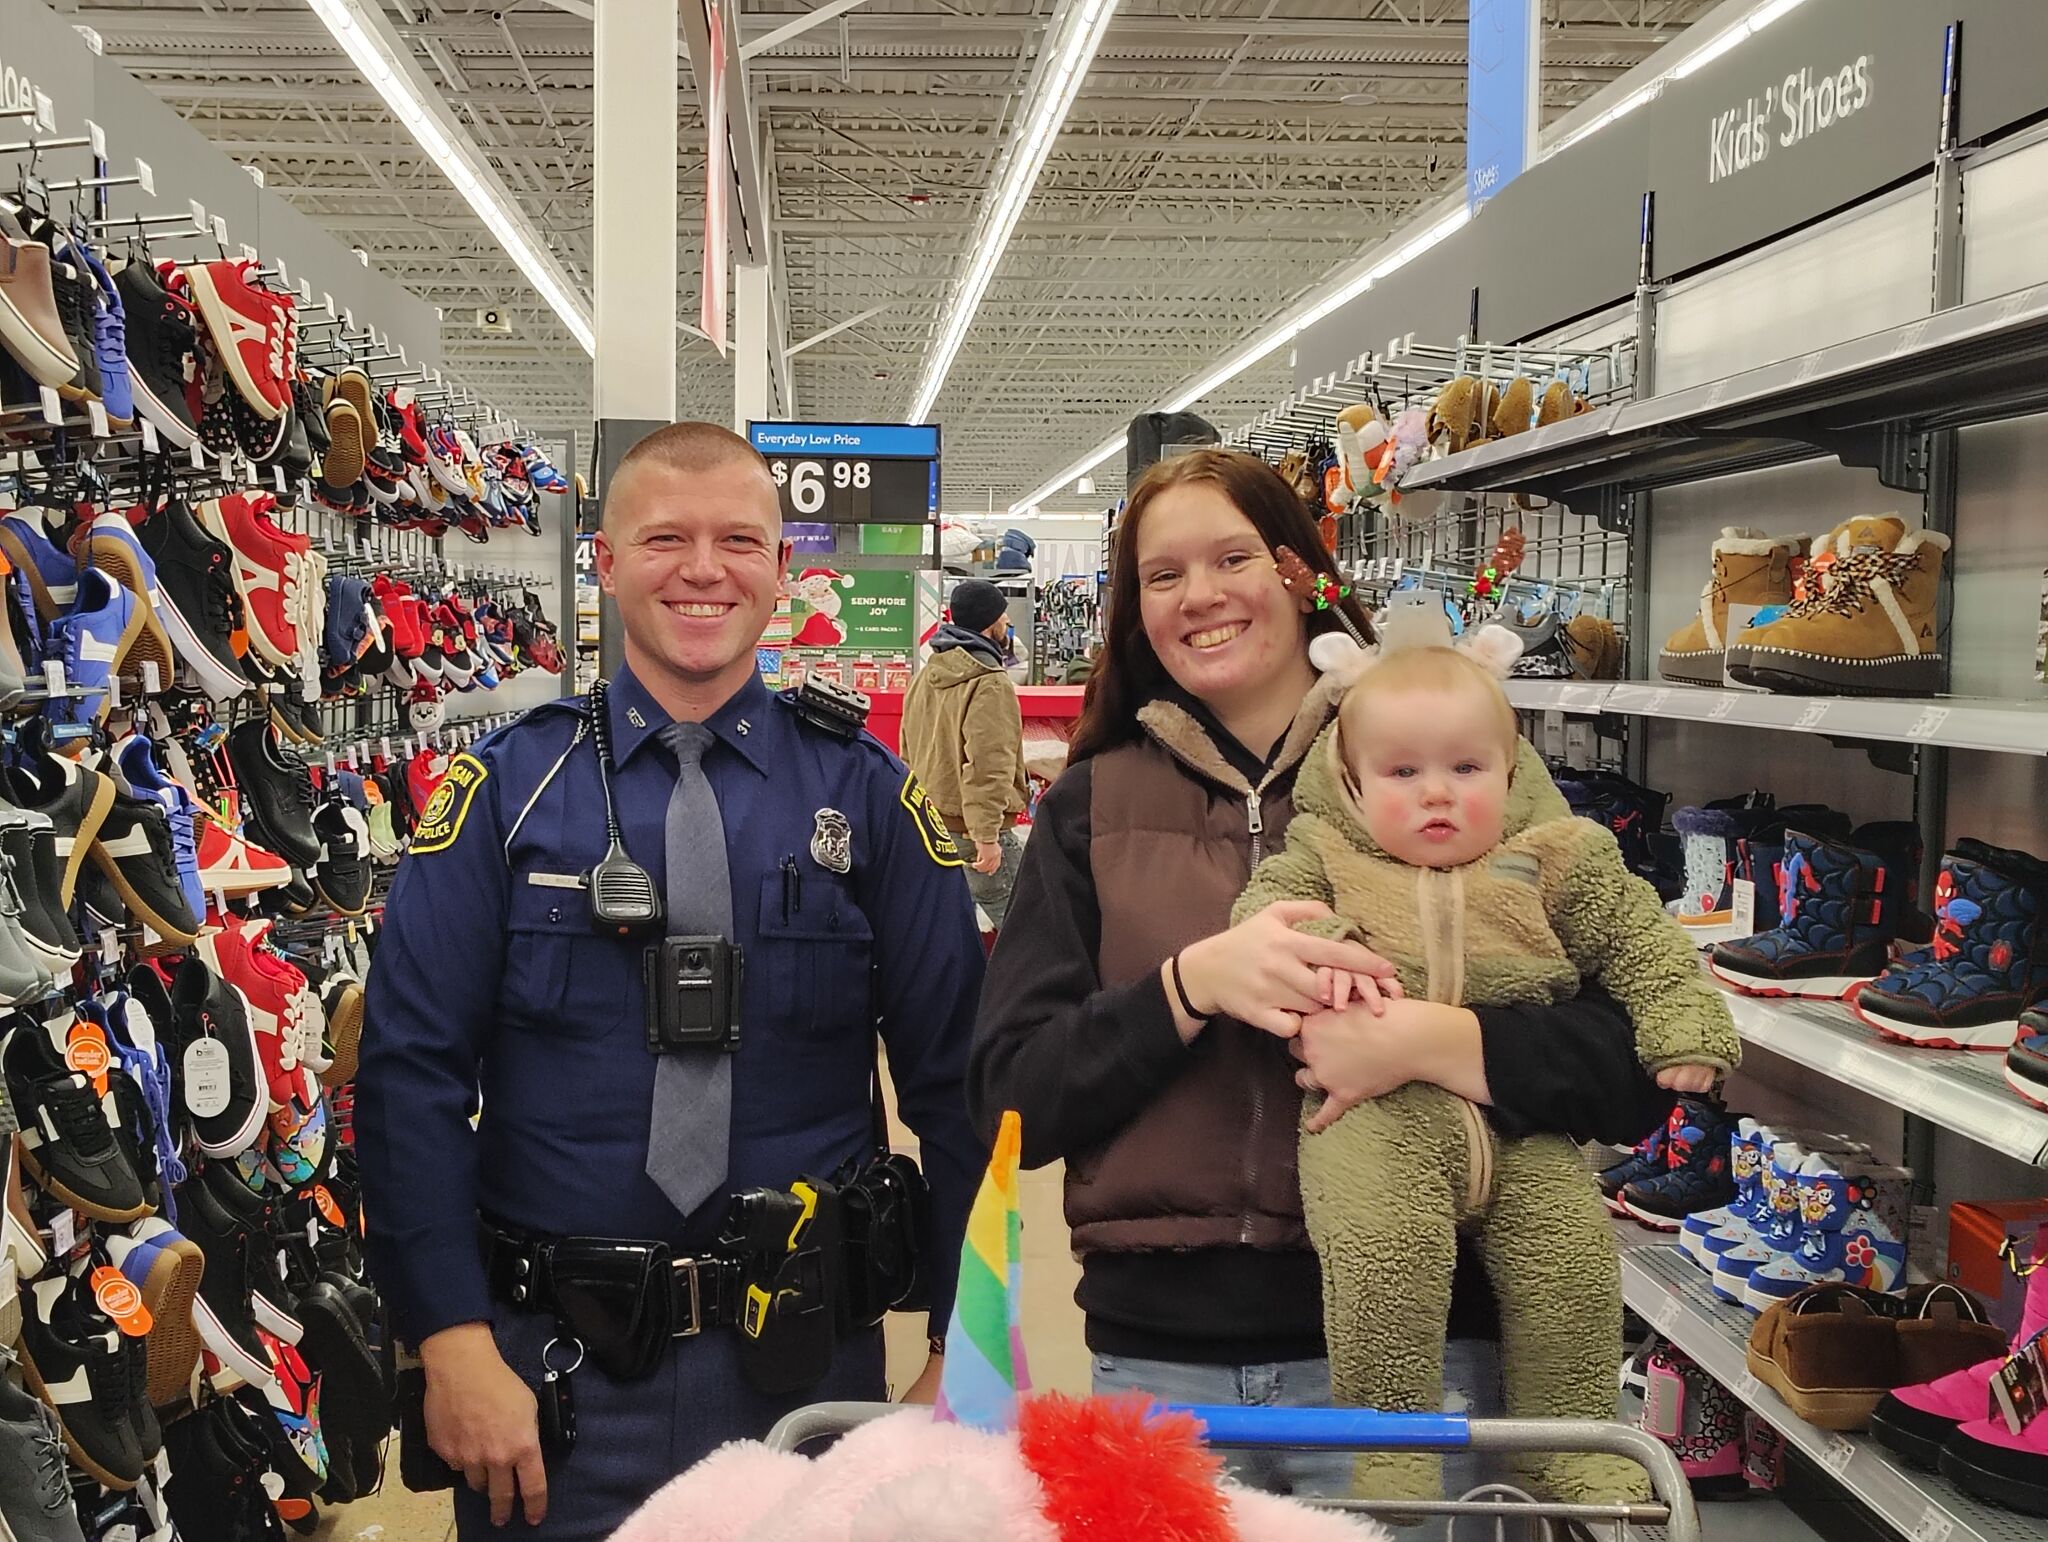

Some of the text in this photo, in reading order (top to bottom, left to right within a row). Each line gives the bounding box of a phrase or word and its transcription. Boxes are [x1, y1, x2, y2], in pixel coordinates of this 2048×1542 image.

[1709, 55, 1868, 184] Kids' Shoes
[757, 432, 861, 446] Everyday Low Price
[851, 597, 906, 606] SEND MORE
[869, 607, 888, 616] JOY
